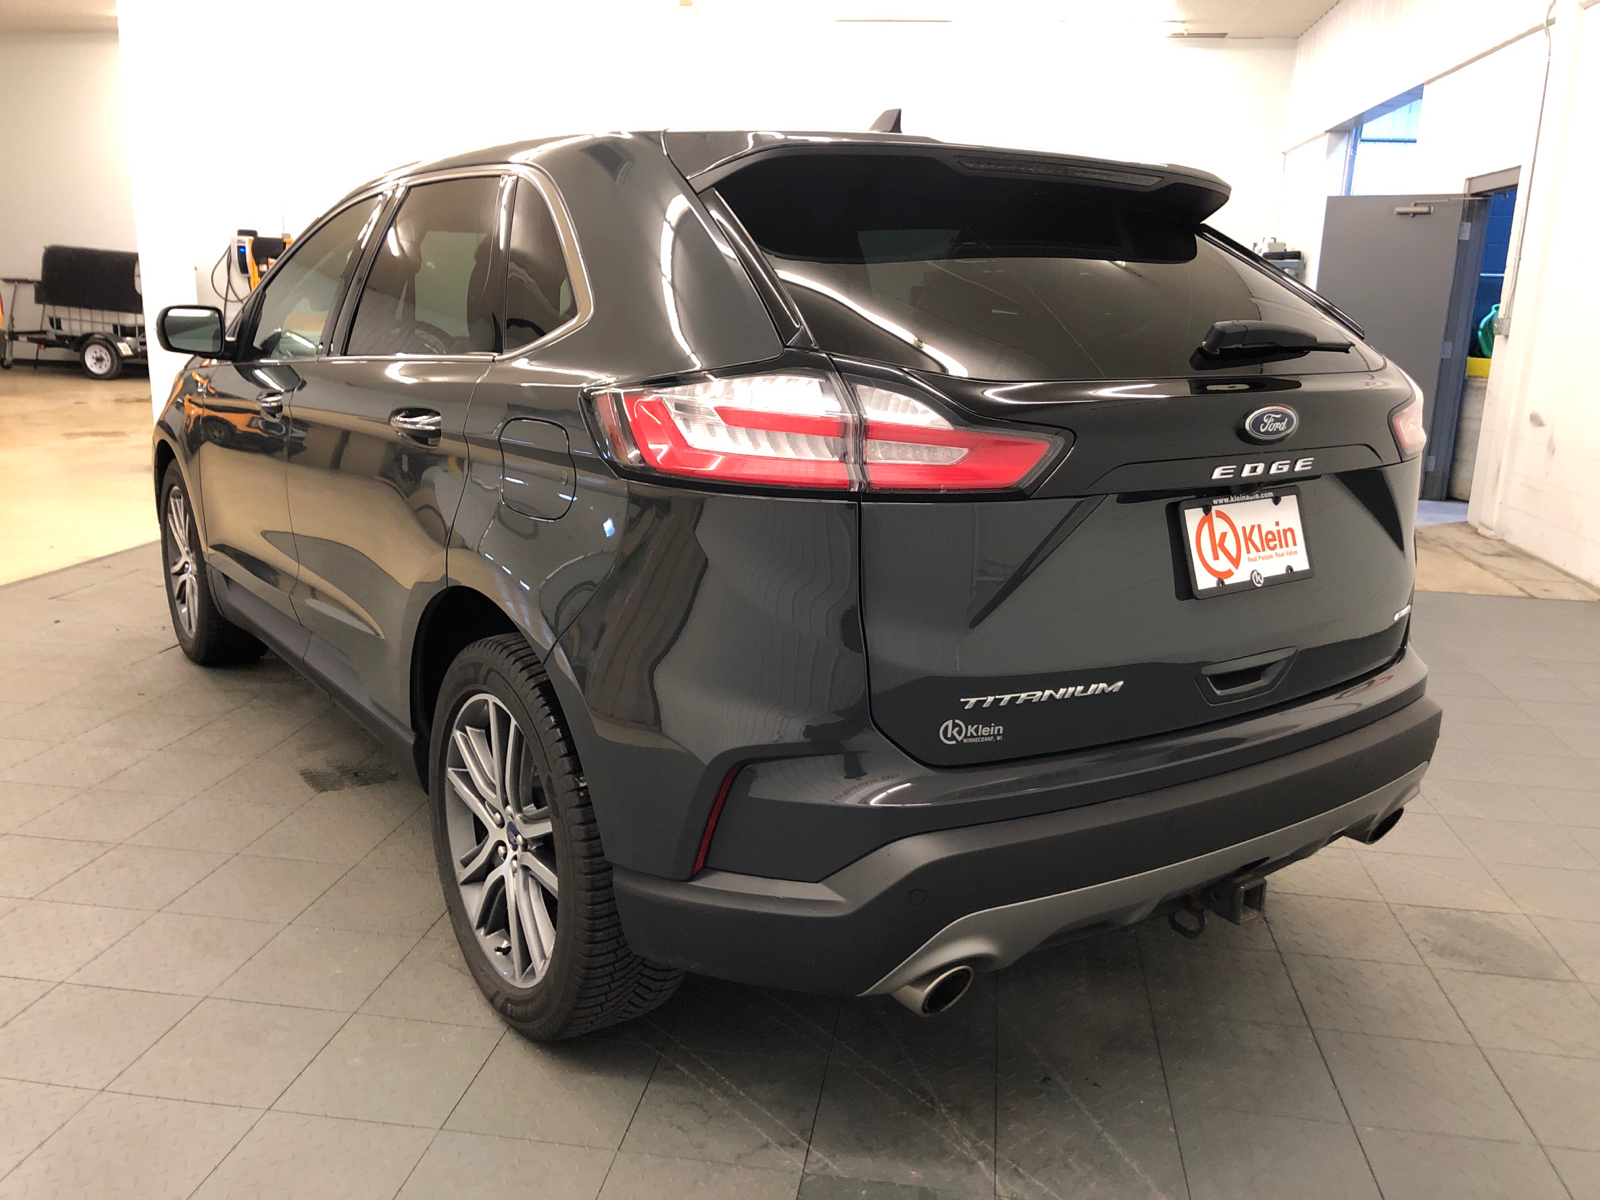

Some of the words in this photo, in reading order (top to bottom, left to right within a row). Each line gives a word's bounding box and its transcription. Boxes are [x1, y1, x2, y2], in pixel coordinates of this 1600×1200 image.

[1260, 414, 1287, 432] Ford
[1211, 457, 1314, 480] EDGE
[1242, 521, 1297, 554] Klein
[1247, 555, 1258, 563] Real
[960, 680, 1124, 709] TITANIUM
[967, 723, 1003, 736] Klein
